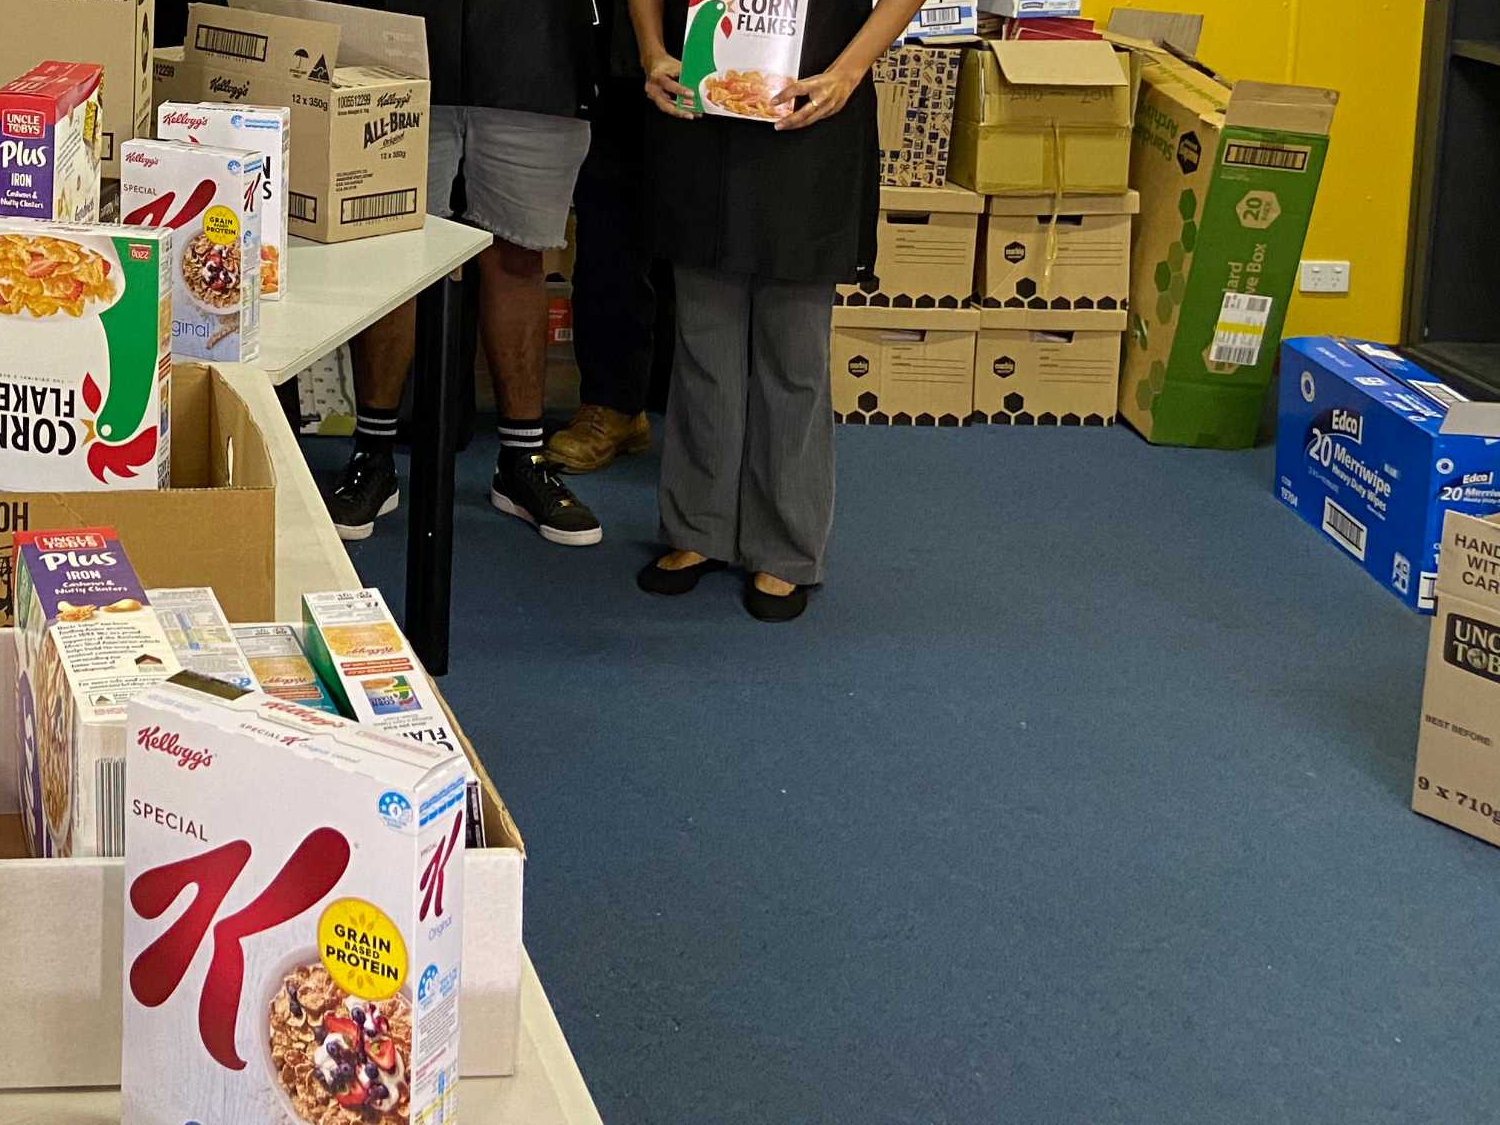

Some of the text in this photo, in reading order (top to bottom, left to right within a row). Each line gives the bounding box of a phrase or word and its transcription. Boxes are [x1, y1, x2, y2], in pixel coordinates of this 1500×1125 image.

[737, 13, 797, 37] FLAKES
[210, 76, 250, 99] Kellogg's
[291, 93, 329, 112] 12 x 350g
[376, 89, 413, 109] Kellogg's
[6, 113, 40, 125] UNCLE
[6, 123, 40, 135] TOBYS
[162, 111, 208, 130] Kellogg's
[363, 111, 421, 149] ALL-BRAN
[0, 140, 49, 168] Plus
[125, 151, 159, 168] Kellogg's
[11, 173, 32, 188] IRON
[123, 183, 157, 196] SPECIAL
[0, 197, 44, 210] Nutty Clusters
[6, 189, 38, 200] Cashews &
[1243, 196, 1263, 222] 20
[206, 226, 237, 236] PROTEIN
[209, 216, 233, 226] GRAIN
[1246, 243, 1267, 272] Box
[1331, 408, 1358, 435] Edco
[1308, 427, 1332, 468] 20
[1334, 442, 1392, 497] Merriwipe
[1331, 463, 1350, 487] Heavy
[1349, 476, 1367, 499] Duty
[1367, 489, 1387, 512] Wipes
[1462, 473, 1488, 484] Edco
[1440, 486, 1463, 502] 20
[38, 551, 118, 572] Plus
[65, 570, 102, 581] IRON
[54, 587, 86, 596] Nutty
[240, 722, 280, 743] SPECIAL
[1425, 714, 1493, 747] BEST BEFORE:
[137, 725, 214, 771] Kellogg's
[1417, 775, 1430, 791] 9
[1435, 784, 1450, 801] x
[419, 809, 463, 922] K
[129, 798, 351, 1073] SPECIAL K
[334, 923, 391, 954] GRAIN
[344, 941, 380, 959] BASED
[325, 944, 399, 981] PROTEIN
